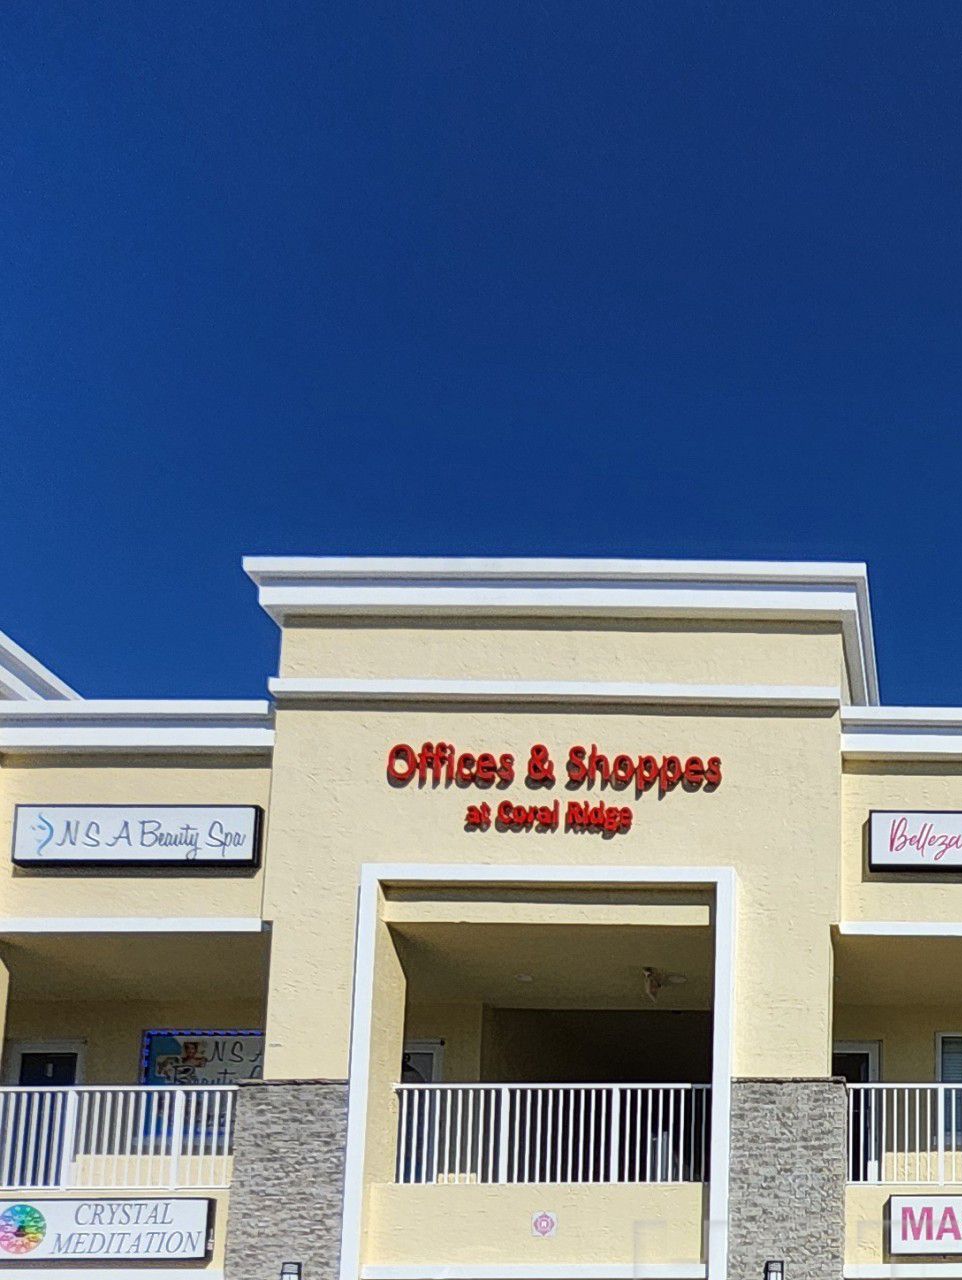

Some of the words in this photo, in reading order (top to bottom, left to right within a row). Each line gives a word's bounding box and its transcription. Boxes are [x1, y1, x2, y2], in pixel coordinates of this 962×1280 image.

[388, 741, 515, 783] Offices
[527, 743, 556, 783] &
[567, 743, 722, 791] Shoppes
[466, 801, 491, 824] at
[497, 799, 560, 824] Coral
[567, 799, 633, 831] Ridge
[138, 820, 202, 861] Beauty
[205, 820, 248, 858] Spa
[75, 1203, 173, 1226] CRYSTAL
[51, 1231, 202, 1255] MEDITATION
